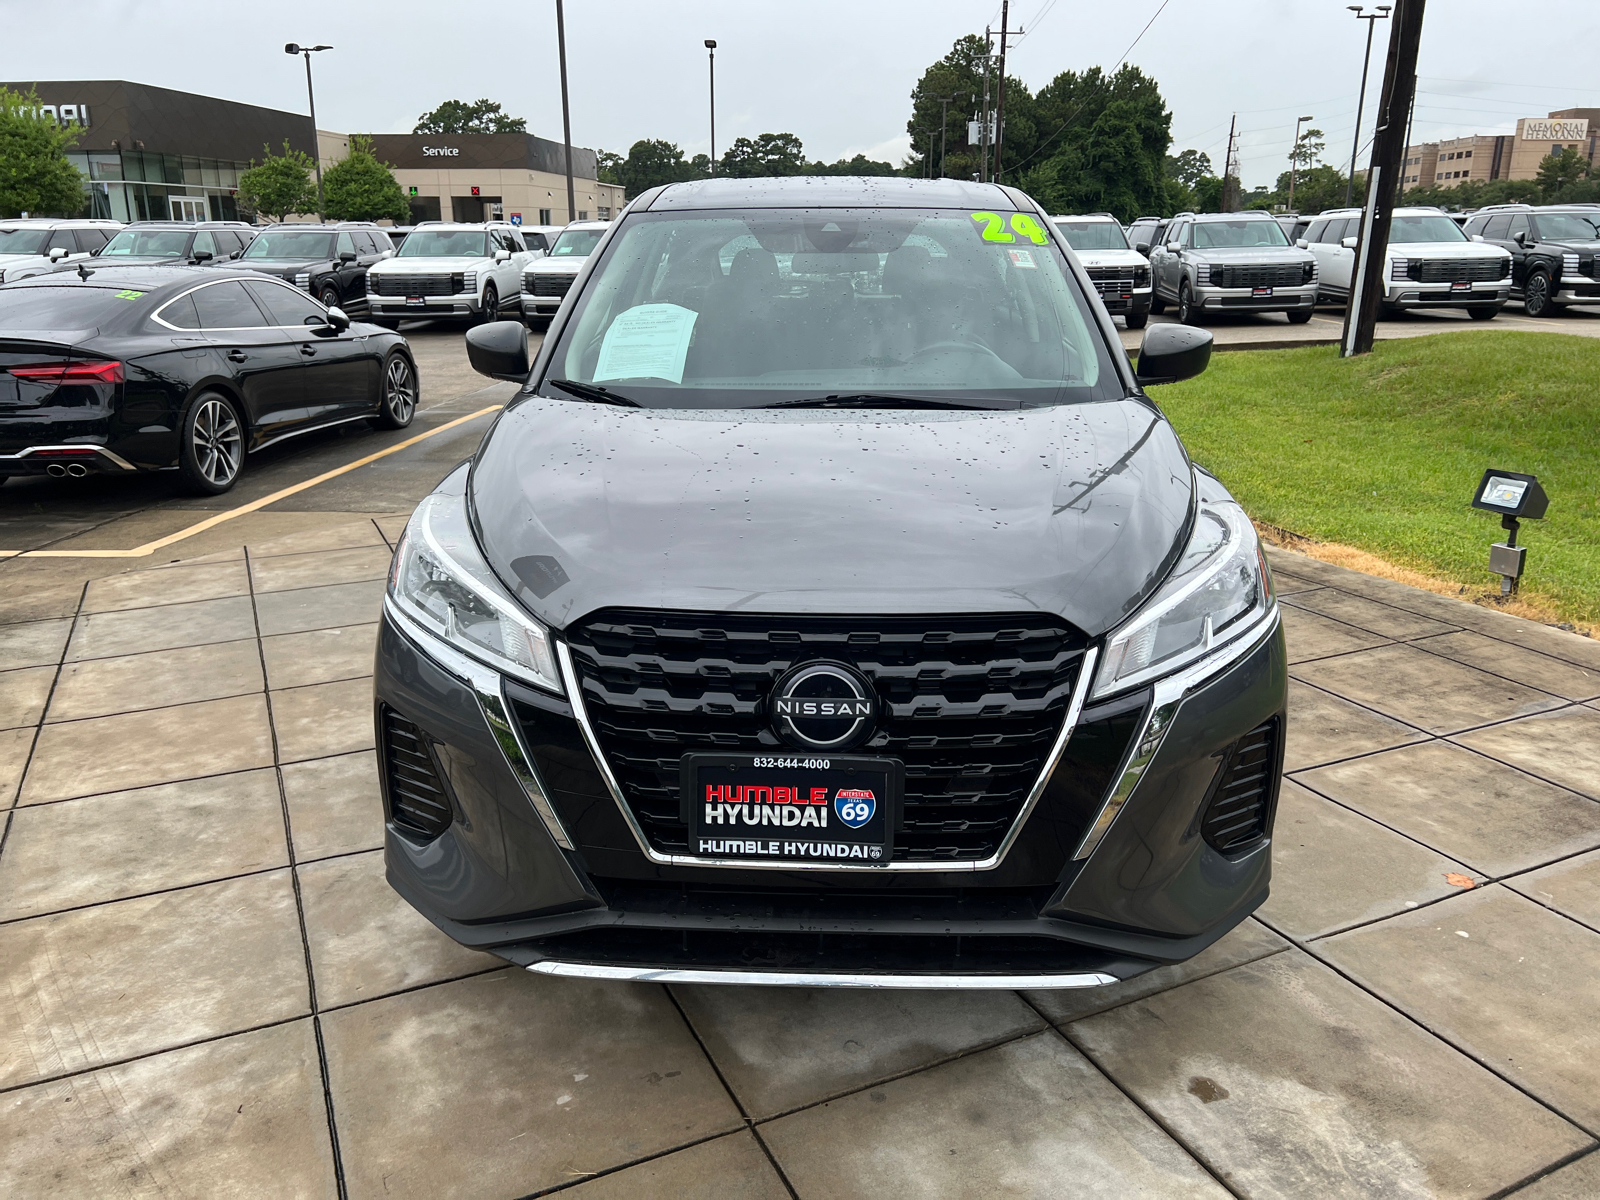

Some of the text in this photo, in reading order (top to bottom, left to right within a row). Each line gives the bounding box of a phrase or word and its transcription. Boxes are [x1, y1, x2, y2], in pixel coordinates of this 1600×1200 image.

[1527, 122, 1585, 132] MEMORIAL
[1525, 130, 1584, 139] HERMANN
[422, 146, 459, 157] Service
[970, 211, 1049, 246] 24
[114, 289, 143, 301] 22
[777, 700, 871, 716] NISSAN
[753, 757, 831, 770] 832-644-4000
[705, 784, 828, 806] HUMBLE
[840, 790, 870, 798] INTERSTATE
[705, 803, 828, 828] HYUNDAI
[841, 803, 869, 821] 69
[699, 840, 868, 858] HUMBLE HYUNDAI
